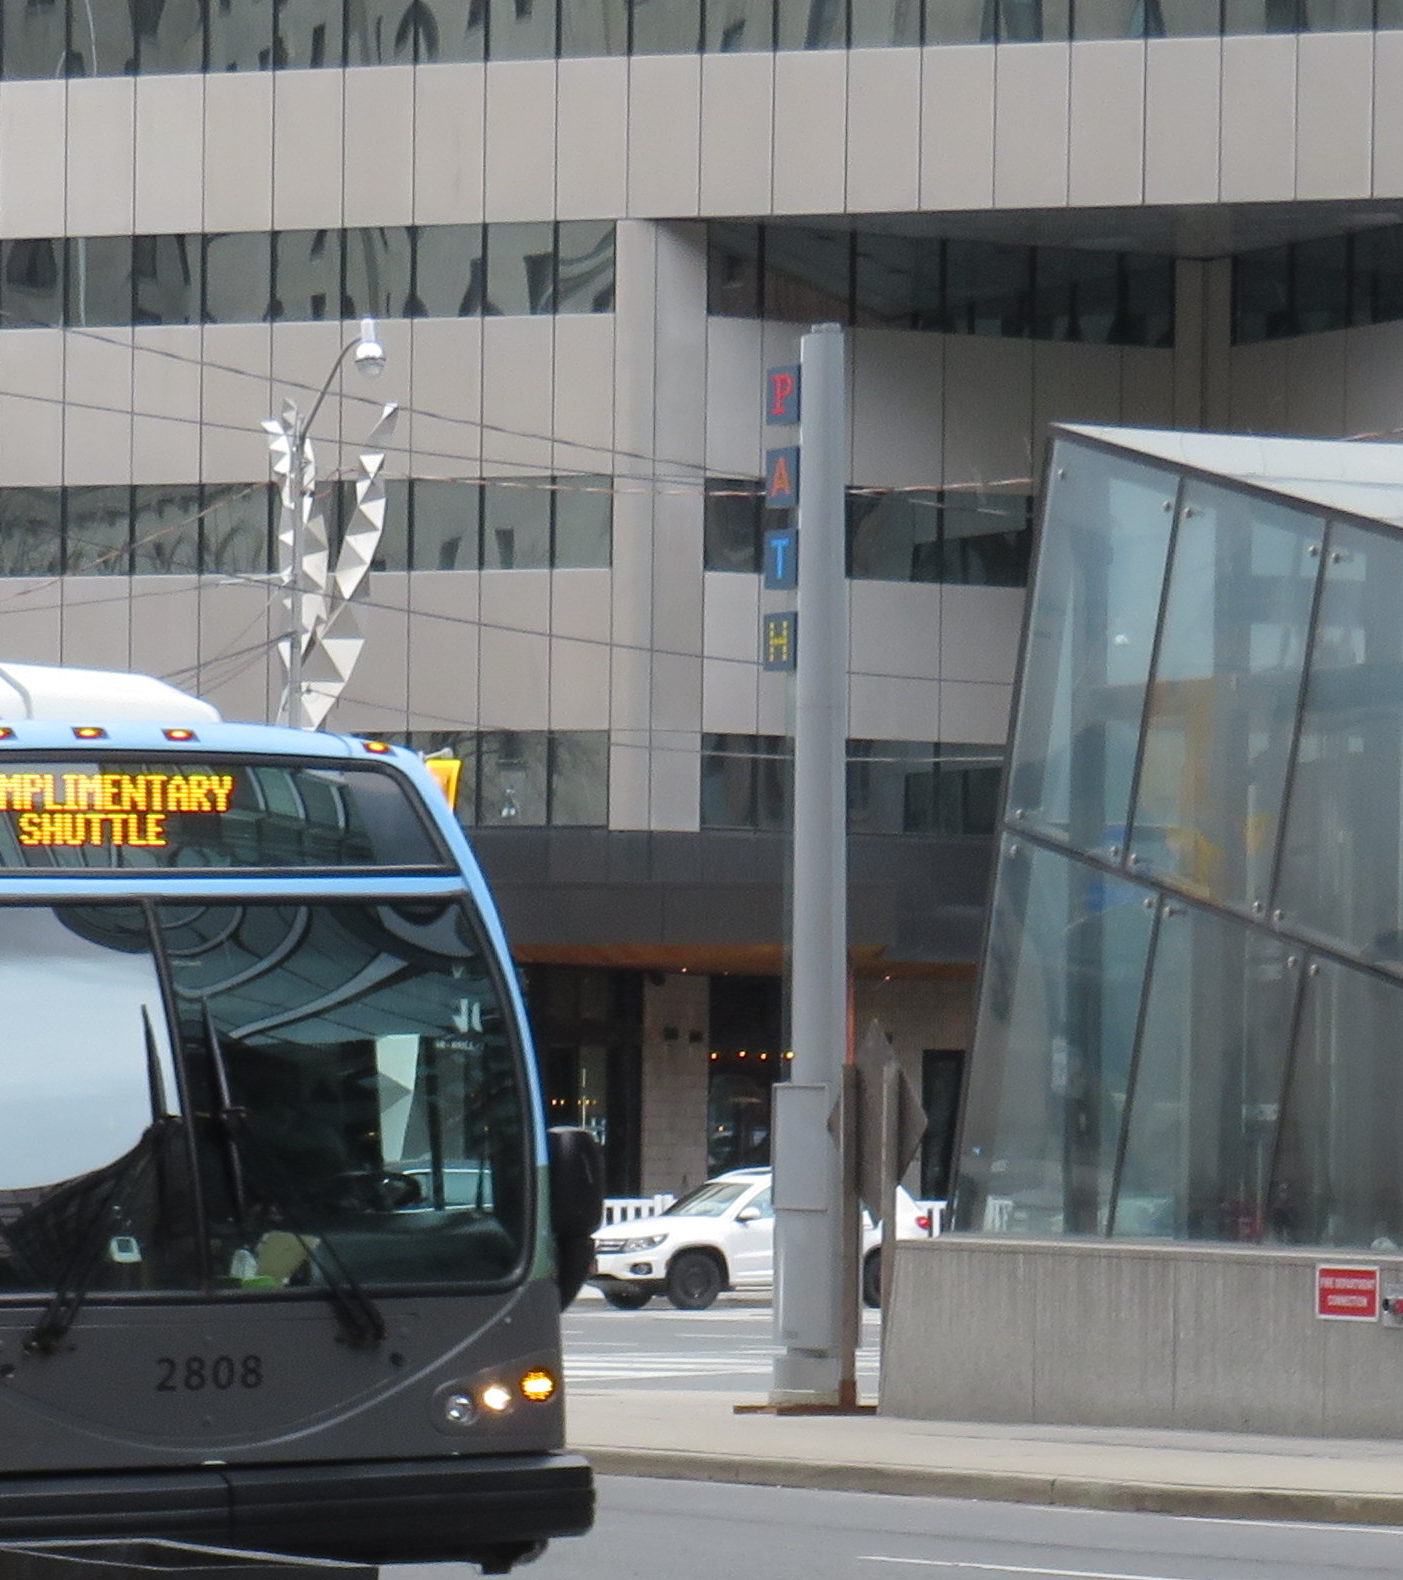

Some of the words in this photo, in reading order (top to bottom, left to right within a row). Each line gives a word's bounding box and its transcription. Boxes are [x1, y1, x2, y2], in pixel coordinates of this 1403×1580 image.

[771, 373, 794, 662] PATH
[17, 812, 168, 846] SHUTTLE
[156, 1354, 264, 1392] 2808
